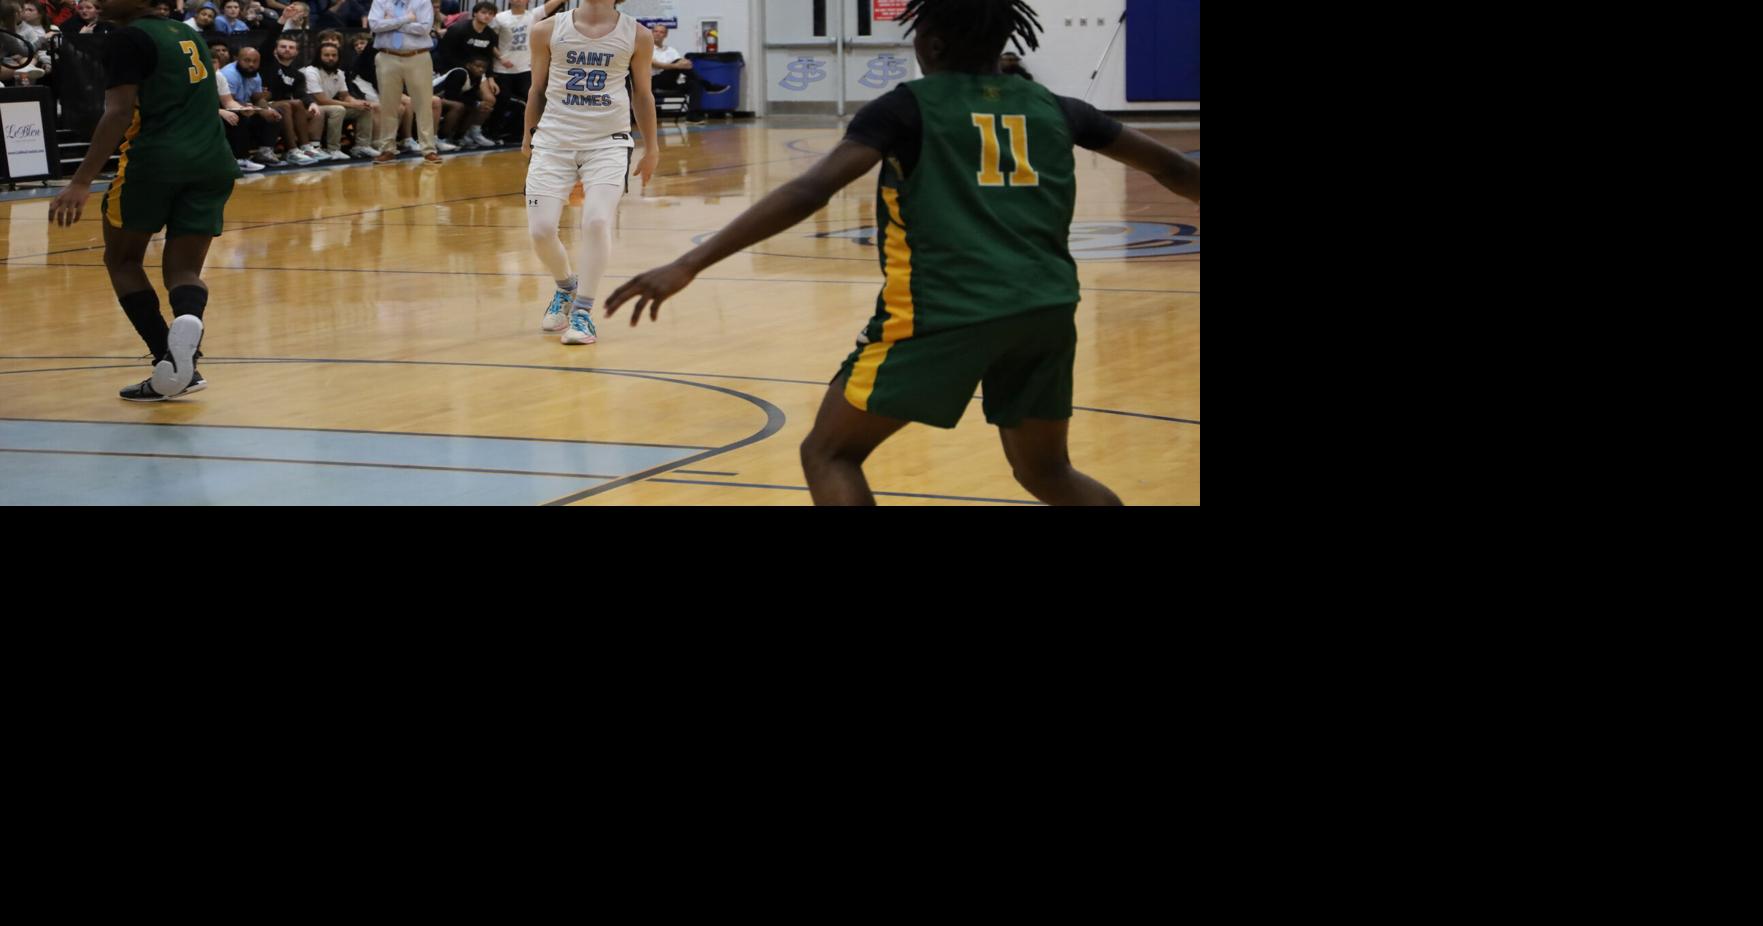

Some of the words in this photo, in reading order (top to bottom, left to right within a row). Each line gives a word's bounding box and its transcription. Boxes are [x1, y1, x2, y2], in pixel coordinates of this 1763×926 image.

[179, 40, 208, 84] 3
[566, 50, 614, 67] SAINT
[565, 67, 608, 91] 20
[561, 93, 612, 107] JAMES
[971, 112, 1039, 187] 11
